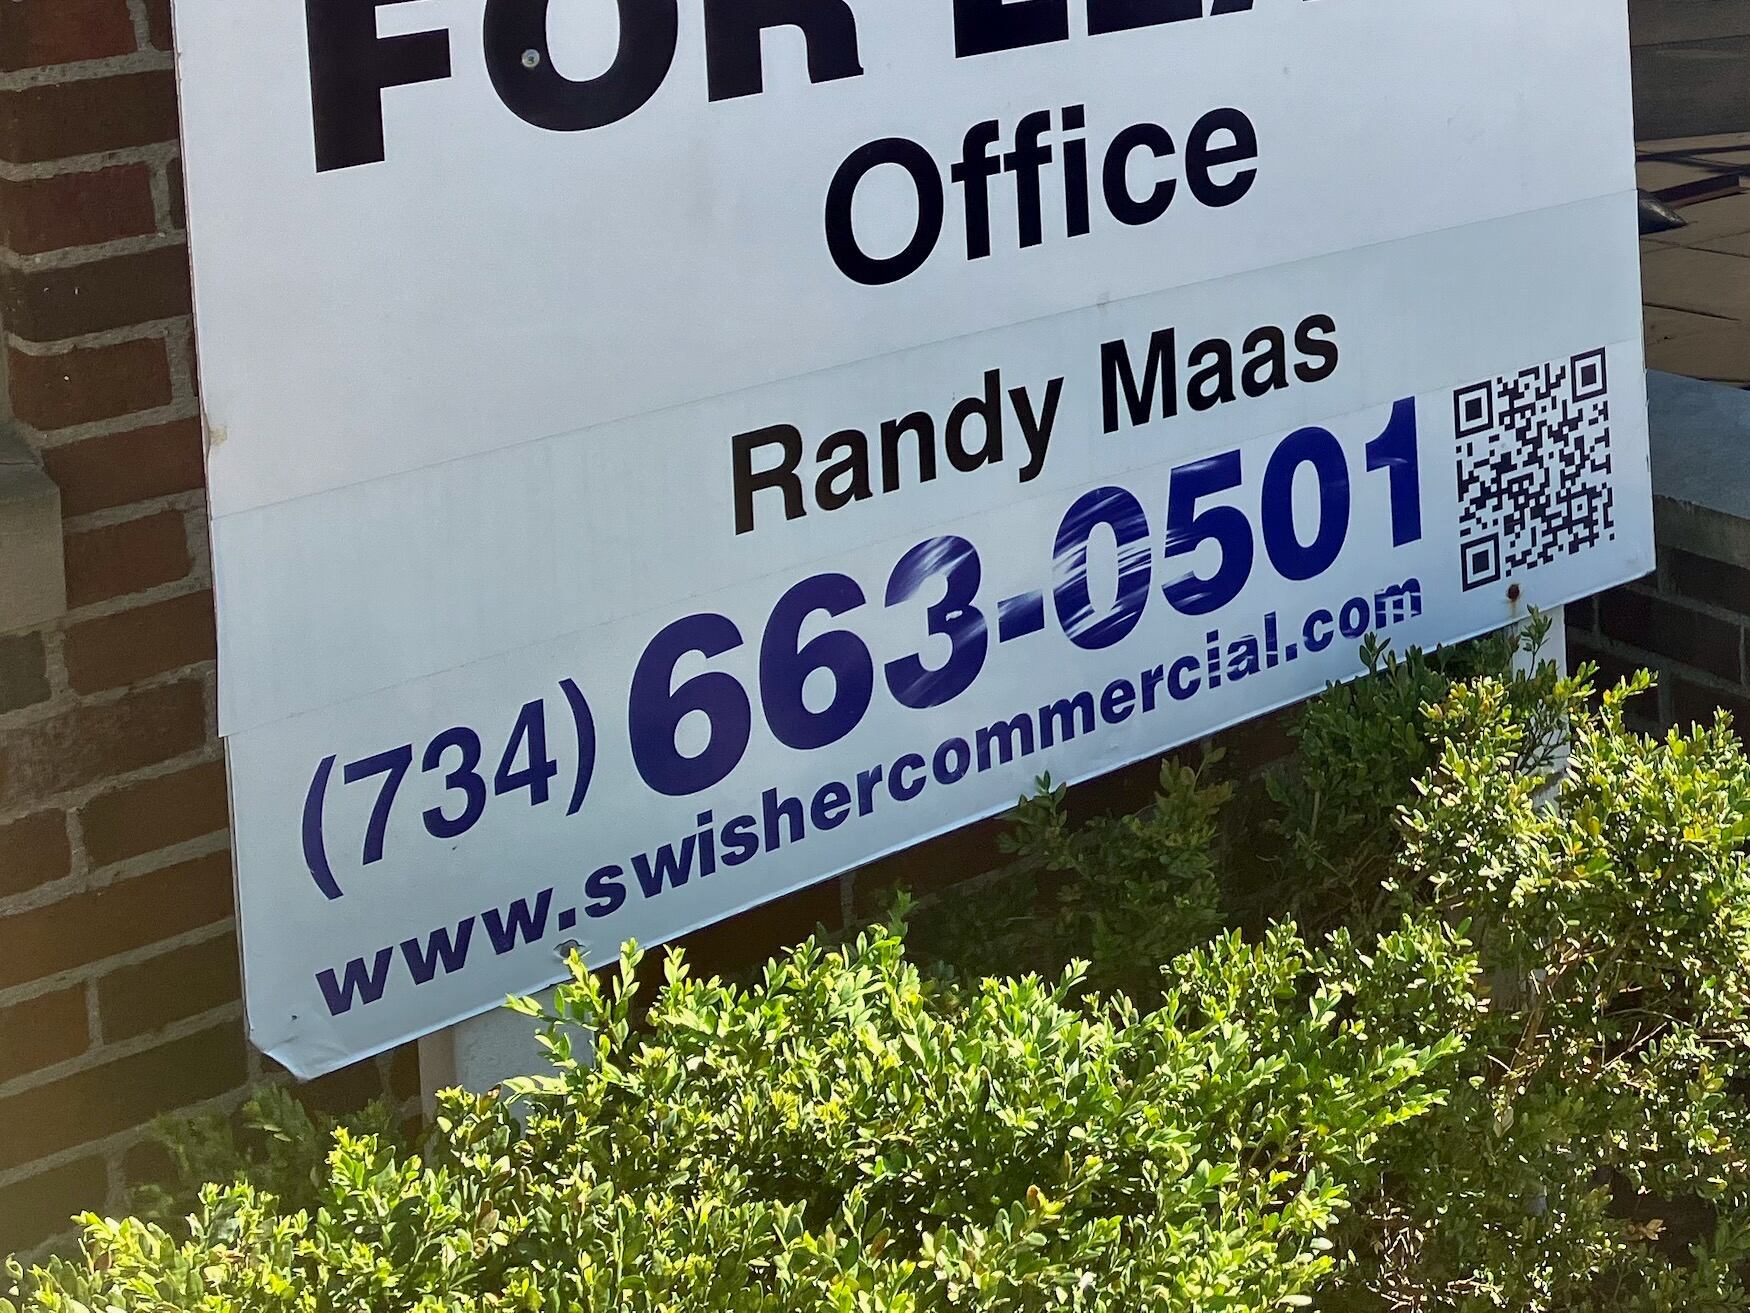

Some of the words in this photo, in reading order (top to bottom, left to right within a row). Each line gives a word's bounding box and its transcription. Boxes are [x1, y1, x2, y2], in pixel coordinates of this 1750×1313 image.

[824, 103, 1258, 286] Office
[731, 368, 1065, 536] Randy
[1100, 313, 1339, 435] Maas
[301, 678, 597, 900] (734)
[628, 395, 1423, 797] 663-0501
[315, 576, 1423, 1017] www.swishercommercial.com
